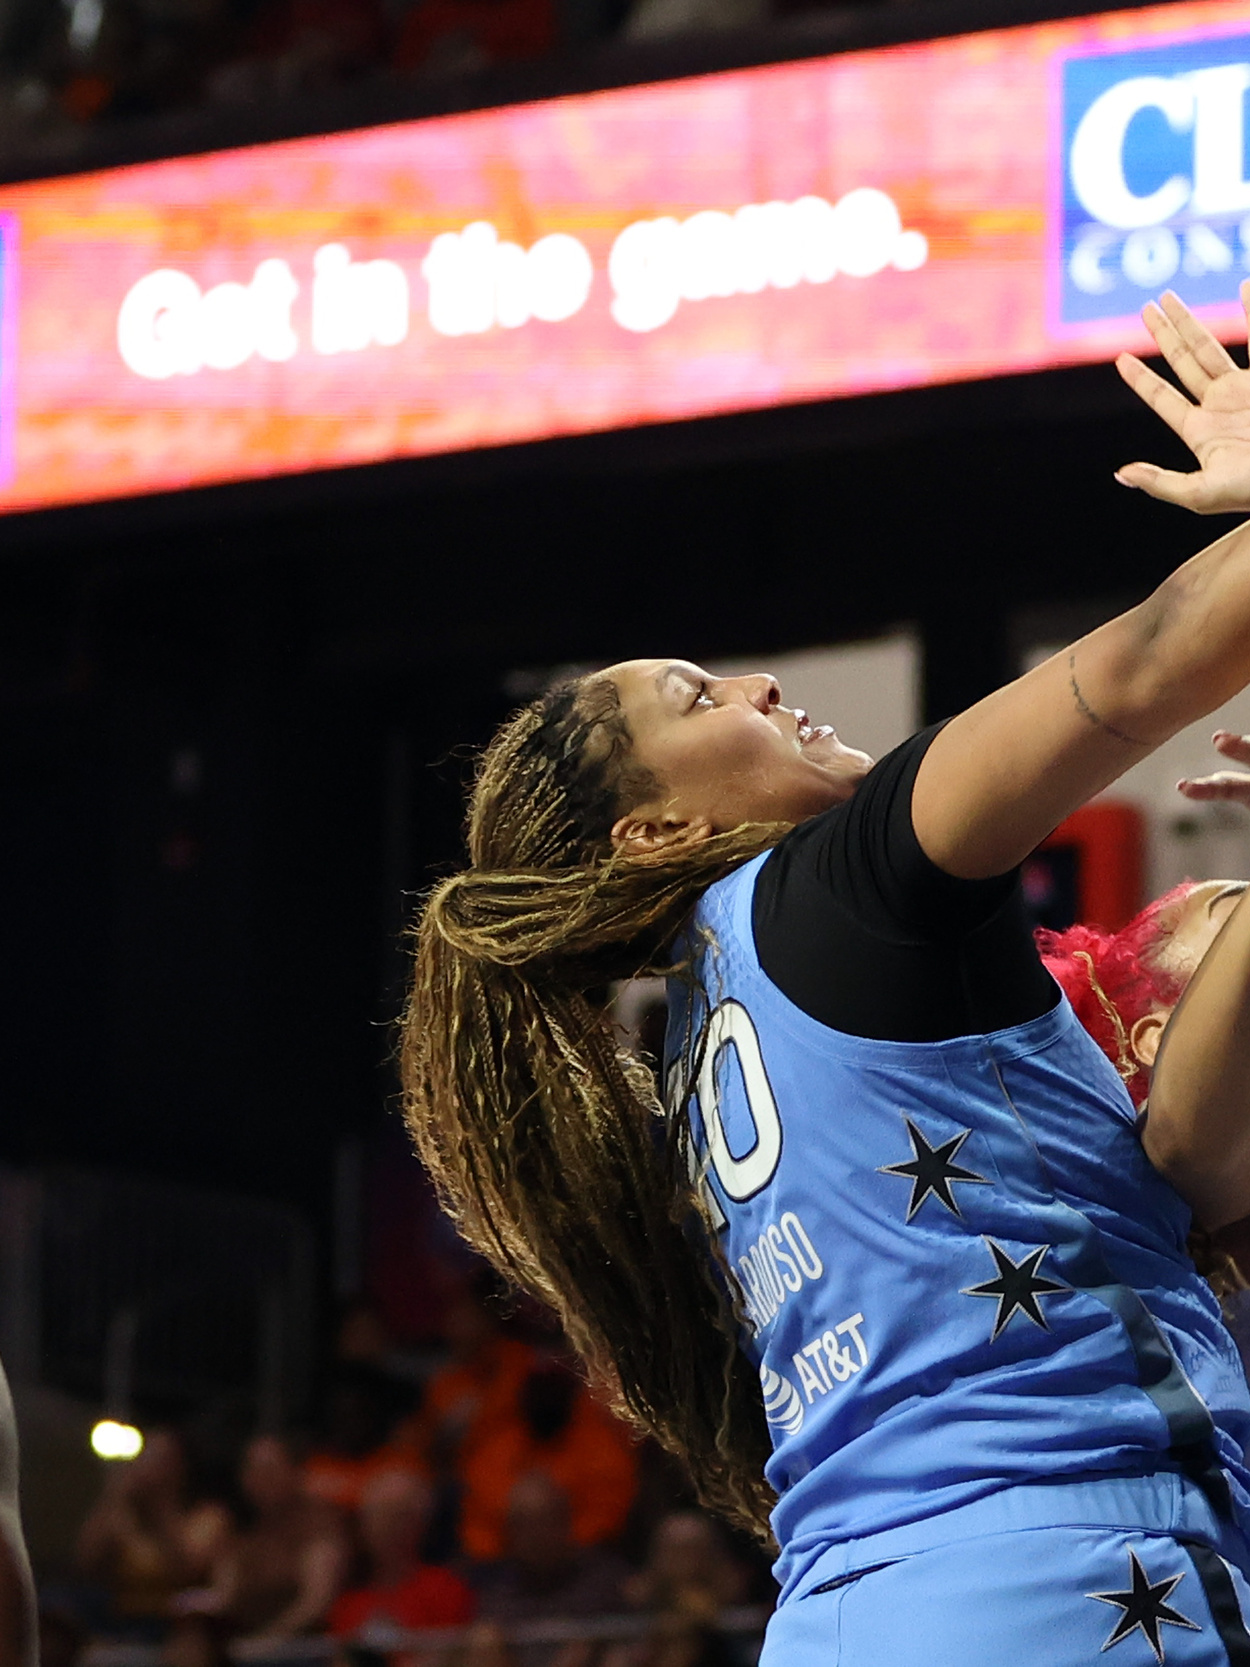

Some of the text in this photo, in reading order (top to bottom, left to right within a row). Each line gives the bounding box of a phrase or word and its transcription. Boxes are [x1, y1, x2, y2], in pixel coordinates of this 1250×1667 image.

[312, 243, 410, 355] in
[422, 221, 593, 336] the
[791, 1312, 869, 1405] AT&T
